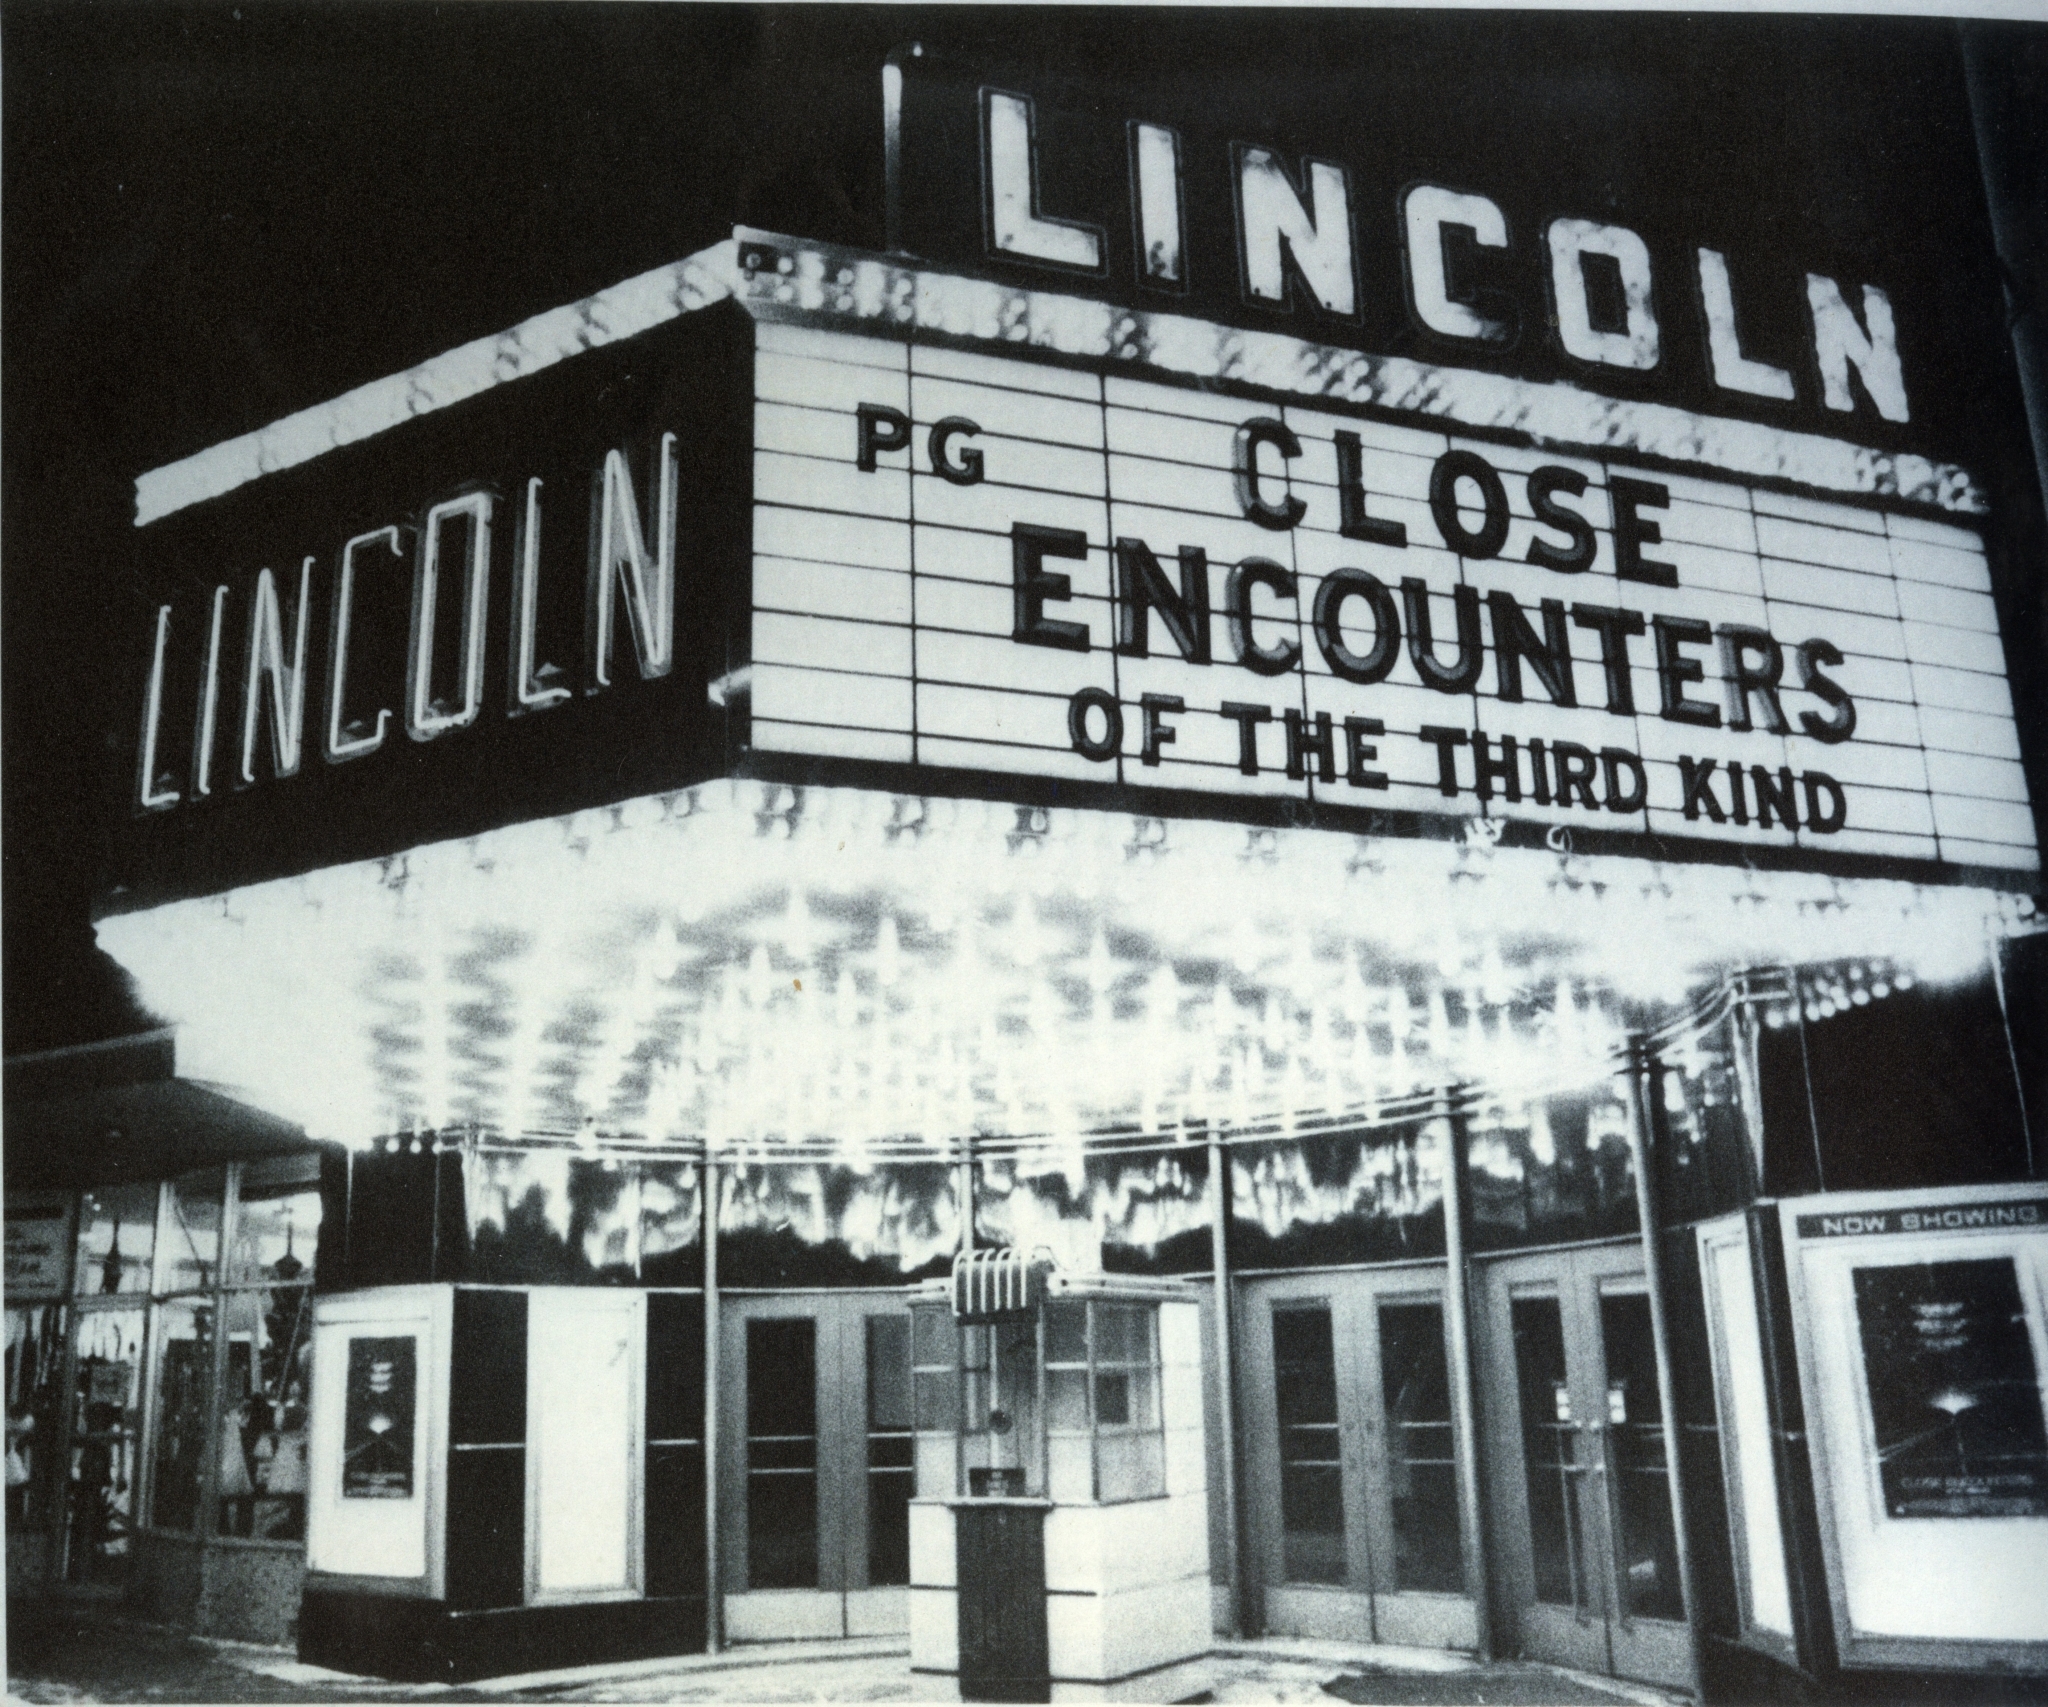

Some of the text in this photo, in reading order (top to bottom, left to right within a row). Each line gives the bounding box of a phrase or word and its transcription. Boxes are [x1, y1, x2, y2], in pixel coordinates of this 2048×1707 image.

[988, 92, 1909, 424] LINCOLN
[857, 402, 984, 486] PG
[1233, 416, 1679, 588] CLOSE
[138, 431, 680, 807] LINCOLN
[1012, 522, 1857, 744] ENCOUNTERS
[1068, 687, 1847, 834] OF THE THIRD KIND
[1822, 1205, 2038, 1235] NOW SHOWING
